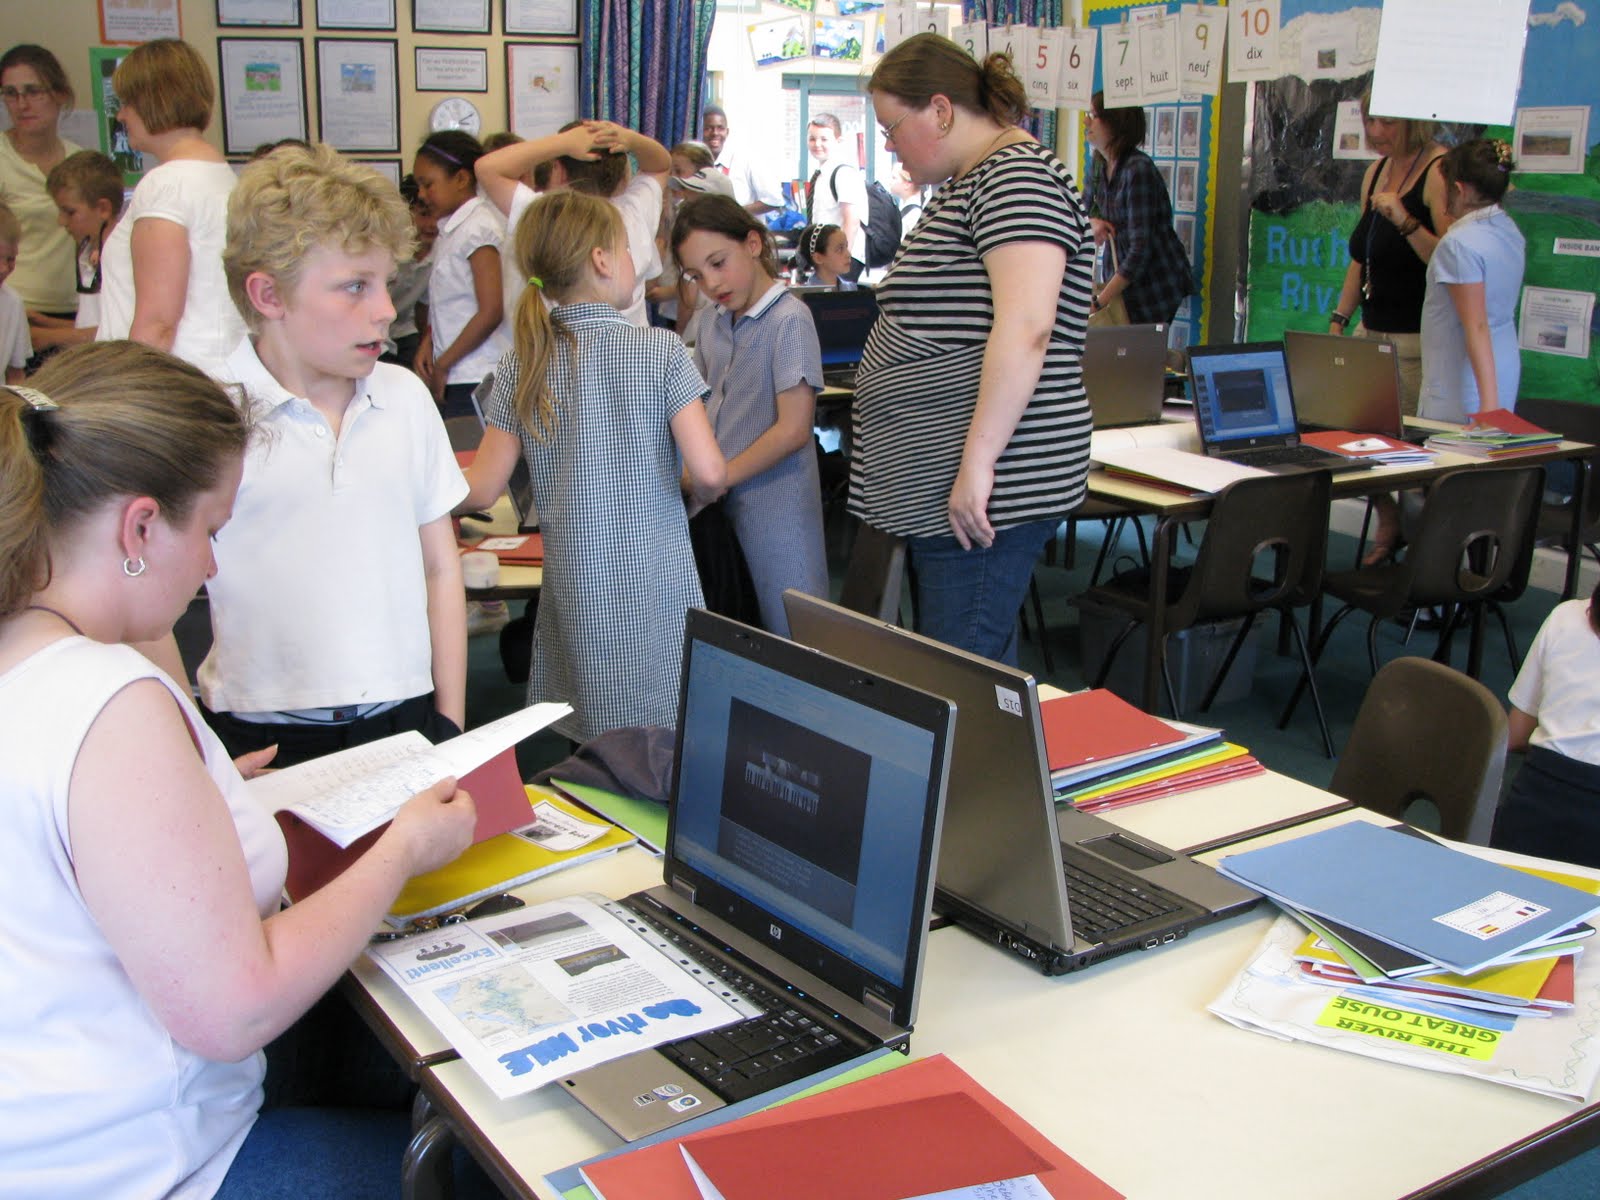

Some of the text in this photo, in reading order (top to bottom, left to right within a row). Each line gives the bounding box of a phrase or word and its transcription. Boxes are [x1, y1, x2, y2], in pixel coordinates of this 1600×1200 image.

[1241, 8, 1270, 37] 10
[1195, 24, 1209, 50] 9
[1036, 45, 1048, 69] 5
[1069, 45, 1081, 69] 6
[1118, 40, 1129, 66] 7
[1246, 46, 1263, 60] dix
[1150, 71, 1169, 84] huit
[1188, 60, 1210, 78] neuf
[1032, 79, 1048, 94] cinq
[1067, 80, 1079, 90] six
[1115, 76, 1134, 91] sept
[1281, 271, 1342, 315] Riv
[405, 946, 496, 980] Excellent!
[1331, 996, 1499, 1043] GREAT OUSE
[1334, 1019, 1472, 1056] THE RIVER
